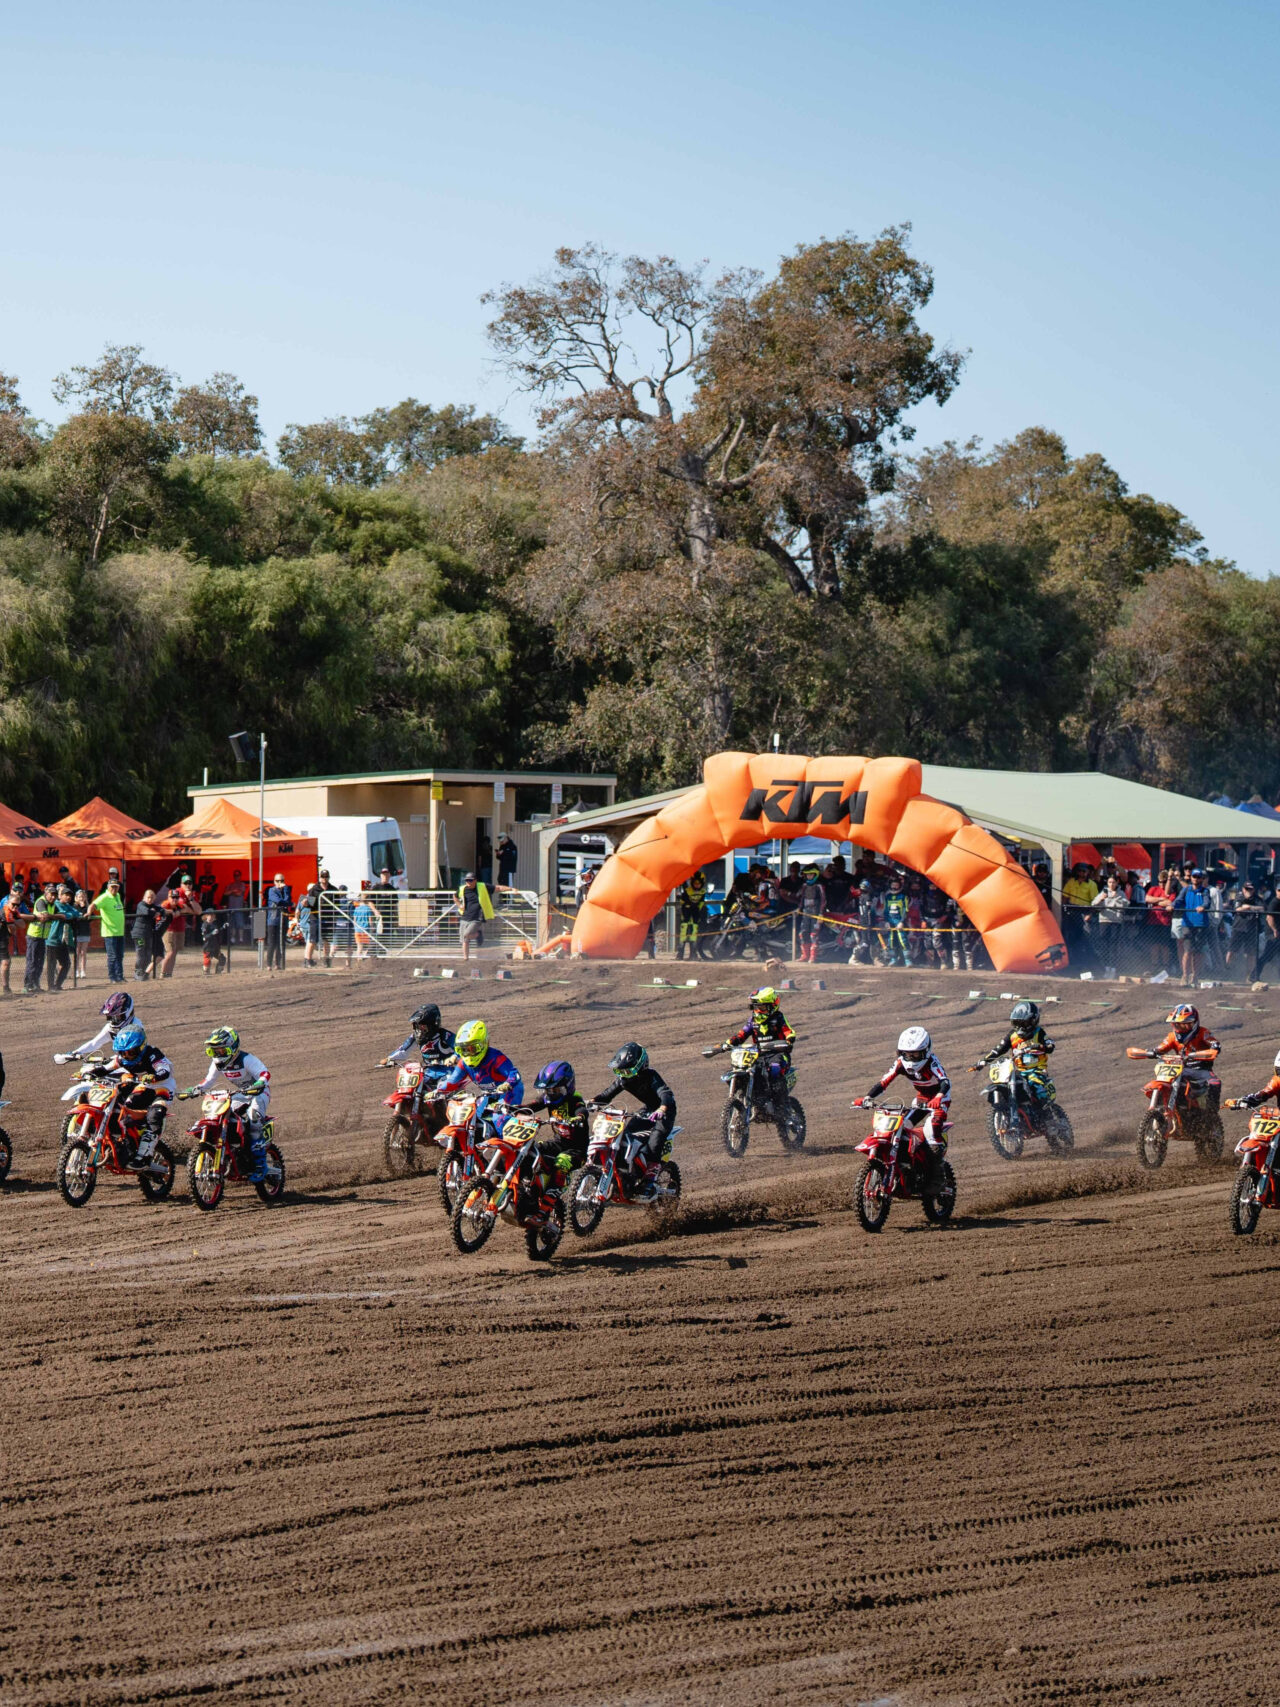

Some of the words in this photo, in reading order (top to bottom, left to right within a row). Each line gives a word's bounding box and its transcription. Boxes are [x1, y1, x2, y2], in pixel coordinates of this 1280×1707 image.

[739, 780, 869, 824] KTM
[14, 826, 53, 840] KTM
[43, 847, 59, 858] KTM
[173, 845, 201, 856] KTM
[278, 842, 294, 853] KTM
[504, 1124, 534, 1140] 426
[1254, 1121, 1277, 1134] 112
